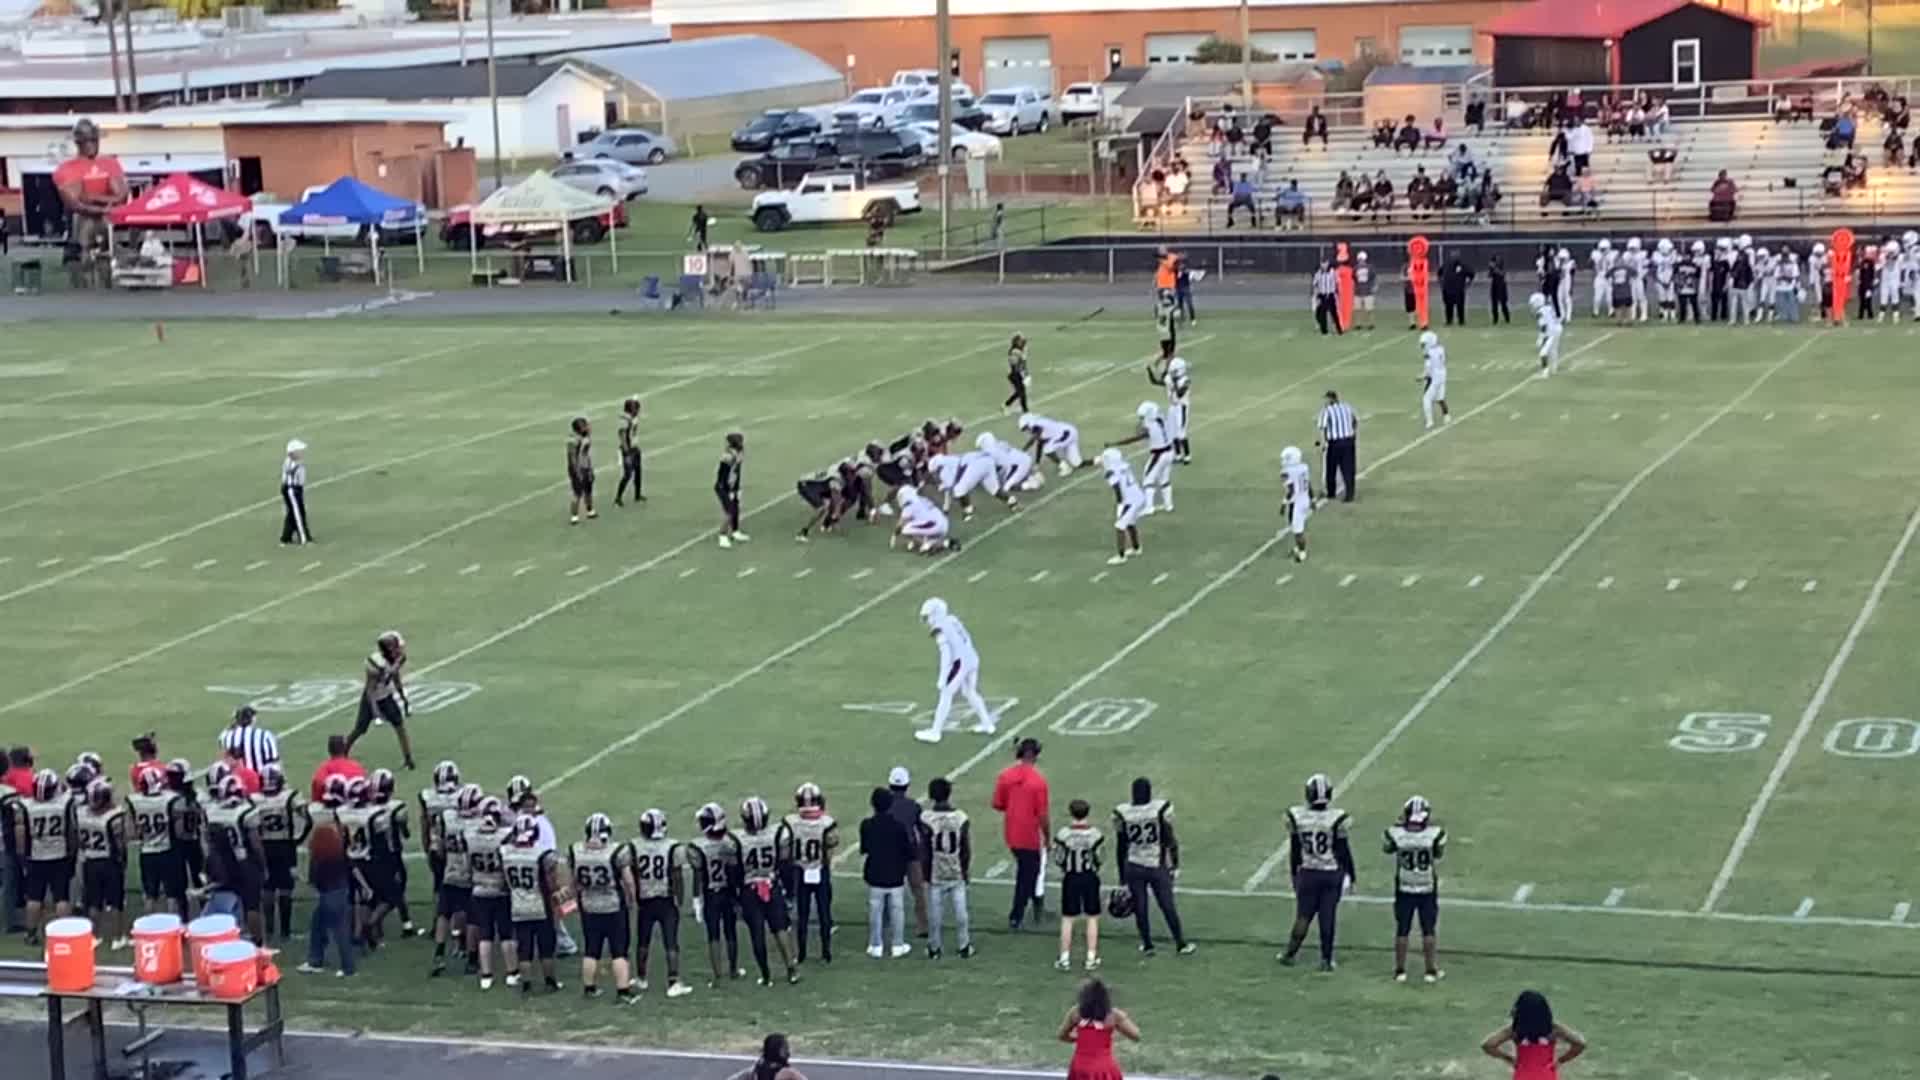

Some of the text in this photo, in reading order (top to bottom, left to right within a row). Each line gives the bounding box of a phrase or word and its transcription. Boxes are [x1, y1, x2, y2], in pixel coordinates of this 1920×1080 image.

[687, 257, 705, 272] 10
[33, 815, 62, 836] 72
[1127, 822, 1158, 846] 23
[794, 837, 821, 863] 10
[1302, 831, 1328, 855] 58
[638, 854, 664, 881] 28
[745, 846, 773, 870] 45
[506, 866, 534, 890] 65
[577, 864, 610, 888] 63
